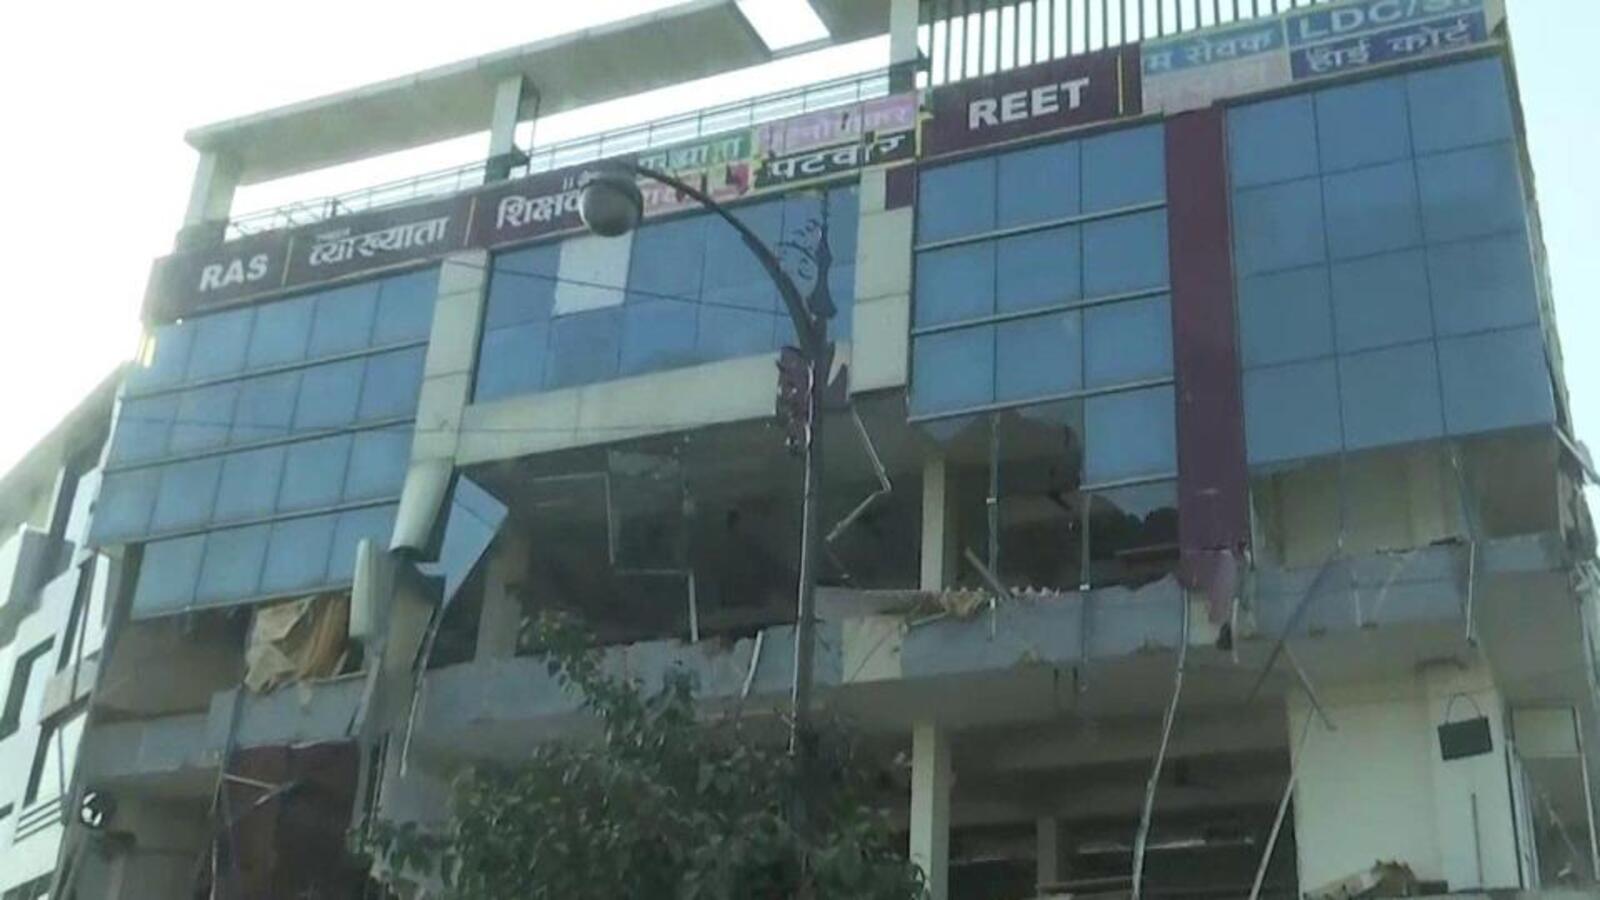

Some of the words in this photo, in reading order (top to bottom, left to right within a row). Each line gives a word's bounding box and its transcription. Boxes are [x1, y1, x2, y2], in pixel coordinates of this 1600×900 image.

[1301, 0, 1471, 39] LDC/
[969, 77, 1090, 129] REET
[772, 133, 906, 177] पटवार
[309, 217, 449, 266] व्याख्याता
[200, 253, 268, 291] RAS
